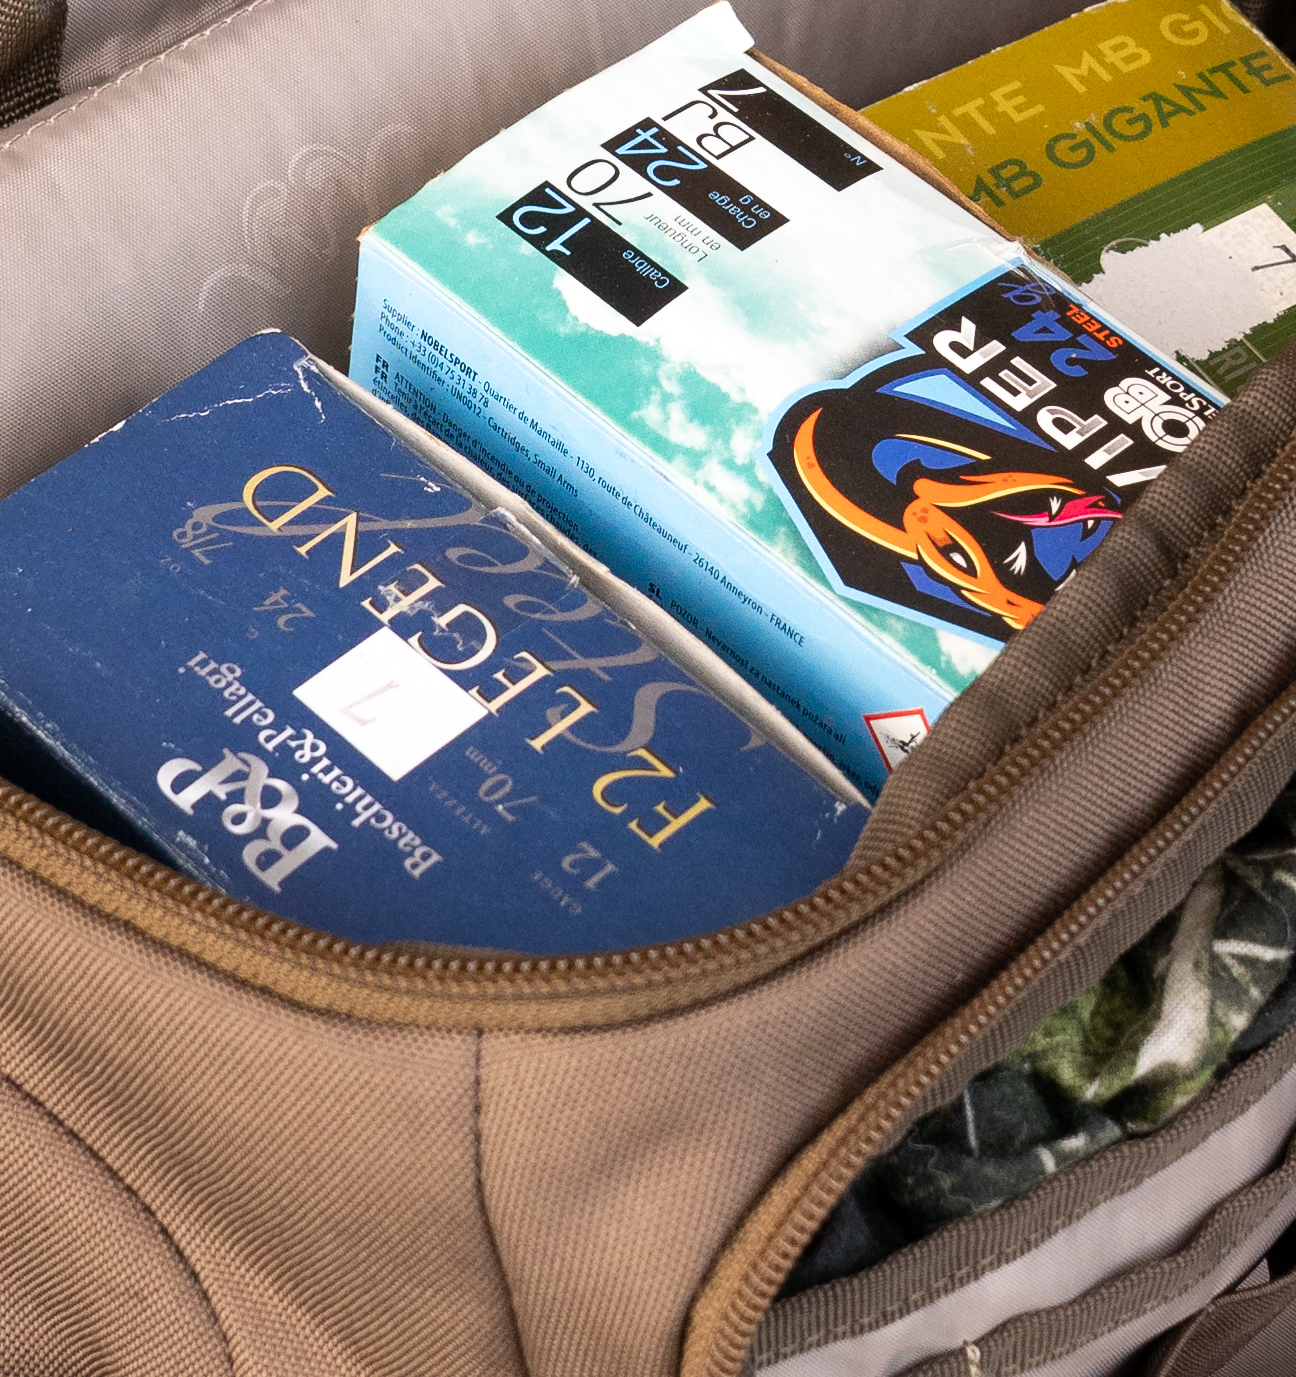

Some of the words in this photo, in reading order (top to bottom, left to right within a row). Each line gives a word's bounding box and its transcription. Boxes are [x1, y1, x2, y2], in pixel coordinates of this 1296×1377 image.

[661, 99, 757, 161] BJ
[706, 85, 768, 113] 7
[913, 80, 1045, 159] NTE
[1052, 34, 1152, 93] MB
[1045, 50, 1291, 170] GIGANTE
[566, 157, 655, 227] 70
[614, 126, 709, 188] 24
[511, 186, 592, 257] 12
[673, 214, 701, 239] mm
[708, 189, 757, 230] Charge
[737, 193, 754, 207] g
[751, 204, 772, 222] en
[621, 248, 671, 290] Calibre
[643, 213, 709, 263] Longueur
[701, 235, 722, 253] en
[379, 312, 405, 337] Phone
[410, 338, 427, 356] +33
[444, 366, 455, 379] 75
[455, 375, 466, 387] 31
[468, 385, 478, 398] 38
[478, 393, 490, 407] 78
[1064, 303, 1124, 349] STEEL
[373, 365, 389, 382] FR
[393, 383, 413, 403] Tenir
[445, 427, 456, 440] de
[377, 324, 409, 355] Product
[407, 351, 446, 386] Identifier
[450, 386, 483, 417] UN0012
[487, 417, 533, 460] Cartridges,
[533, 455, 557, 478] Small
[557, 474, 579, 497] Arms
[1104, 376, 1207, 453] OB
[374, 354, 391, 371] FR
[394, 372, 438, 413] ATTENTION
[441, 413, 471, 442] Danger
[472, 439, 514, 477] d'incendie
[514, 475, 525, 486] ou
[526, 483, 537, 496] de
[537, 492, 583, 534] projection.
[381, 299, 416, 332] Supplier
[420, 329, 478, 380] NOBELSPORT
[483, 381, 517, 413] Quartier
[519, 410, 529, 423] de
[529, 419, 569, 456] Mantaille
[575, 457, 598, 480] 1130,
[597, 476, 621, 499] route
[622, 495, 633, 508] de
[633, 504, 687, 552] Châteauneuf
[694, 554, 720, 579] 26140
[720, 576, 763, 616] Anneyron
[770, 613, 805, 646] FRANCE
[191, 473, 771, 753] Steel
[242, 463, 600, 755] LEGEND
[253, 586, 316, 633] 24
[647, 582, 664, 599] SL
[670, 599, 699, 628] POZOR
[704, 628, 749, 668] Nevarnost
[339, 678, 401, 728] 7
[177, 649, 445, 881] Baschieri&Pellagri
[591, 745, 720, 853] F2
[155, 746, 340, 895] B&P
[559, 839, 619, 892] 12
